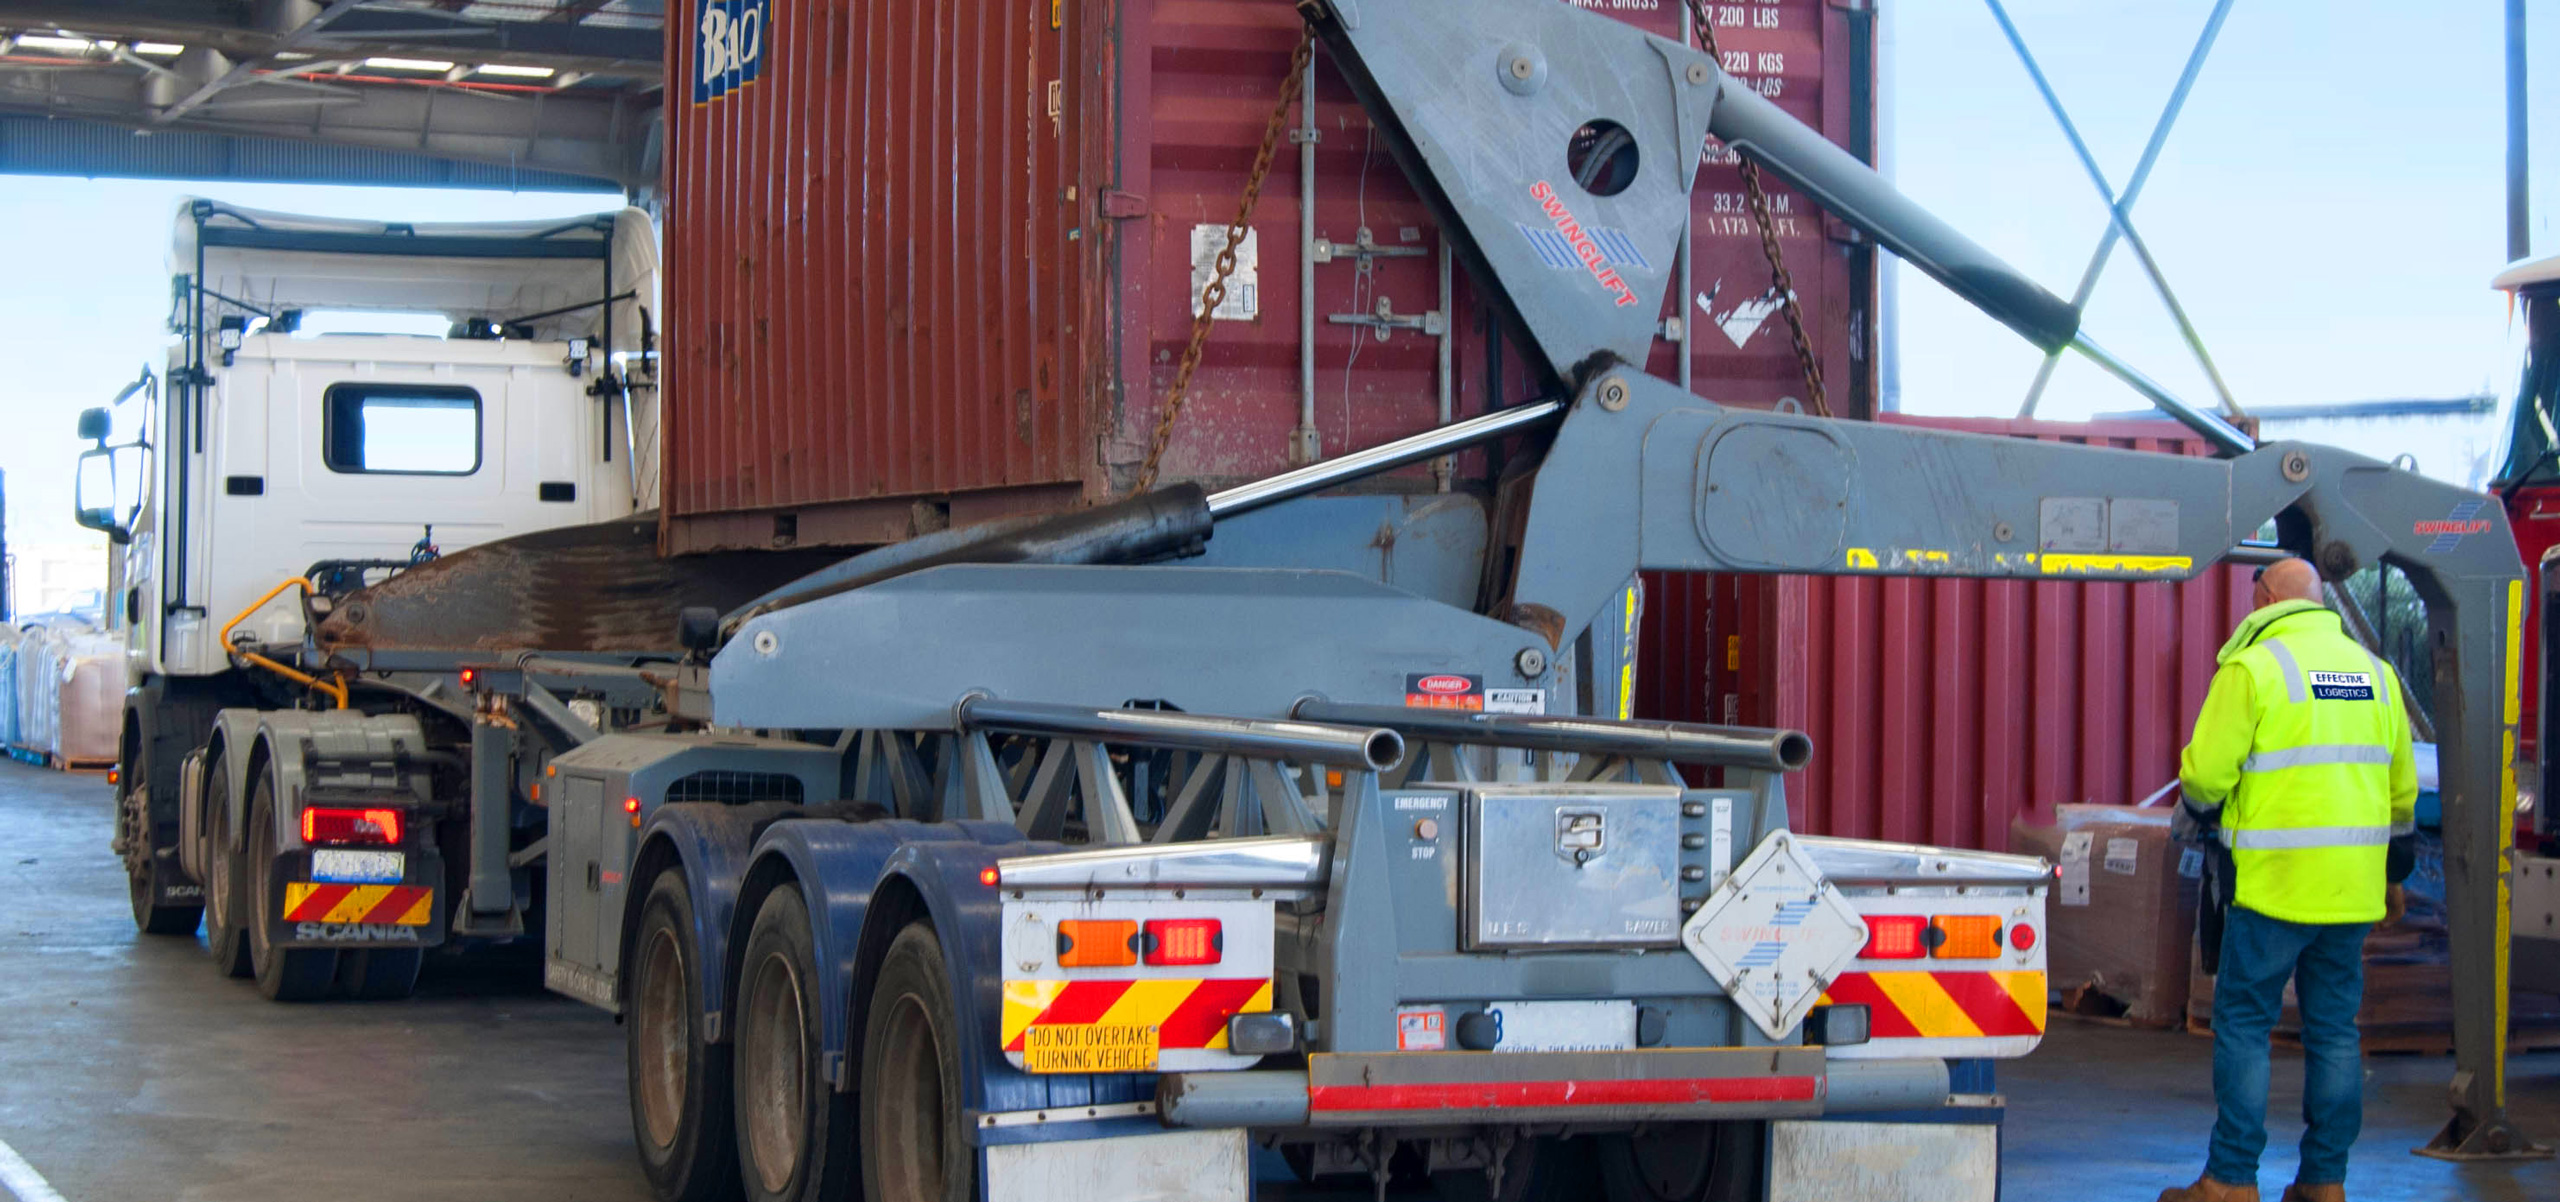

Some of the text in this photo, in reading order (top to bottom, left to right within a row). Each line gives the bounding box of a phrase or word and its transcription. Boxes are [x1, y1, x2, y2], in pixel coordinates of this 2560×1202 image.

[1753, 7, 1779, 29] LBS
[1758, 52, 1784, 74] KGS
[1714, 193, 1744, 213] 33.2
[1529, 181, 1638, 306] SWINGLIFT
[1426, 679, 1463, 690] DANGER
[2316, 674, 2364, 683] EFFECTIVE
[2319, 688, 2368, 698] LOGISTICS
[1394, 797, 1448, 810] EMERGENCY
[1412, 847, 1435, 860] STOP
[296, 923, 419, 942] SCANIA
[1033, 1026, 1150, 1047] DO NOT OVERTAKE
[1036, 1048, 1149, 1069] TURNING VEHICLE
